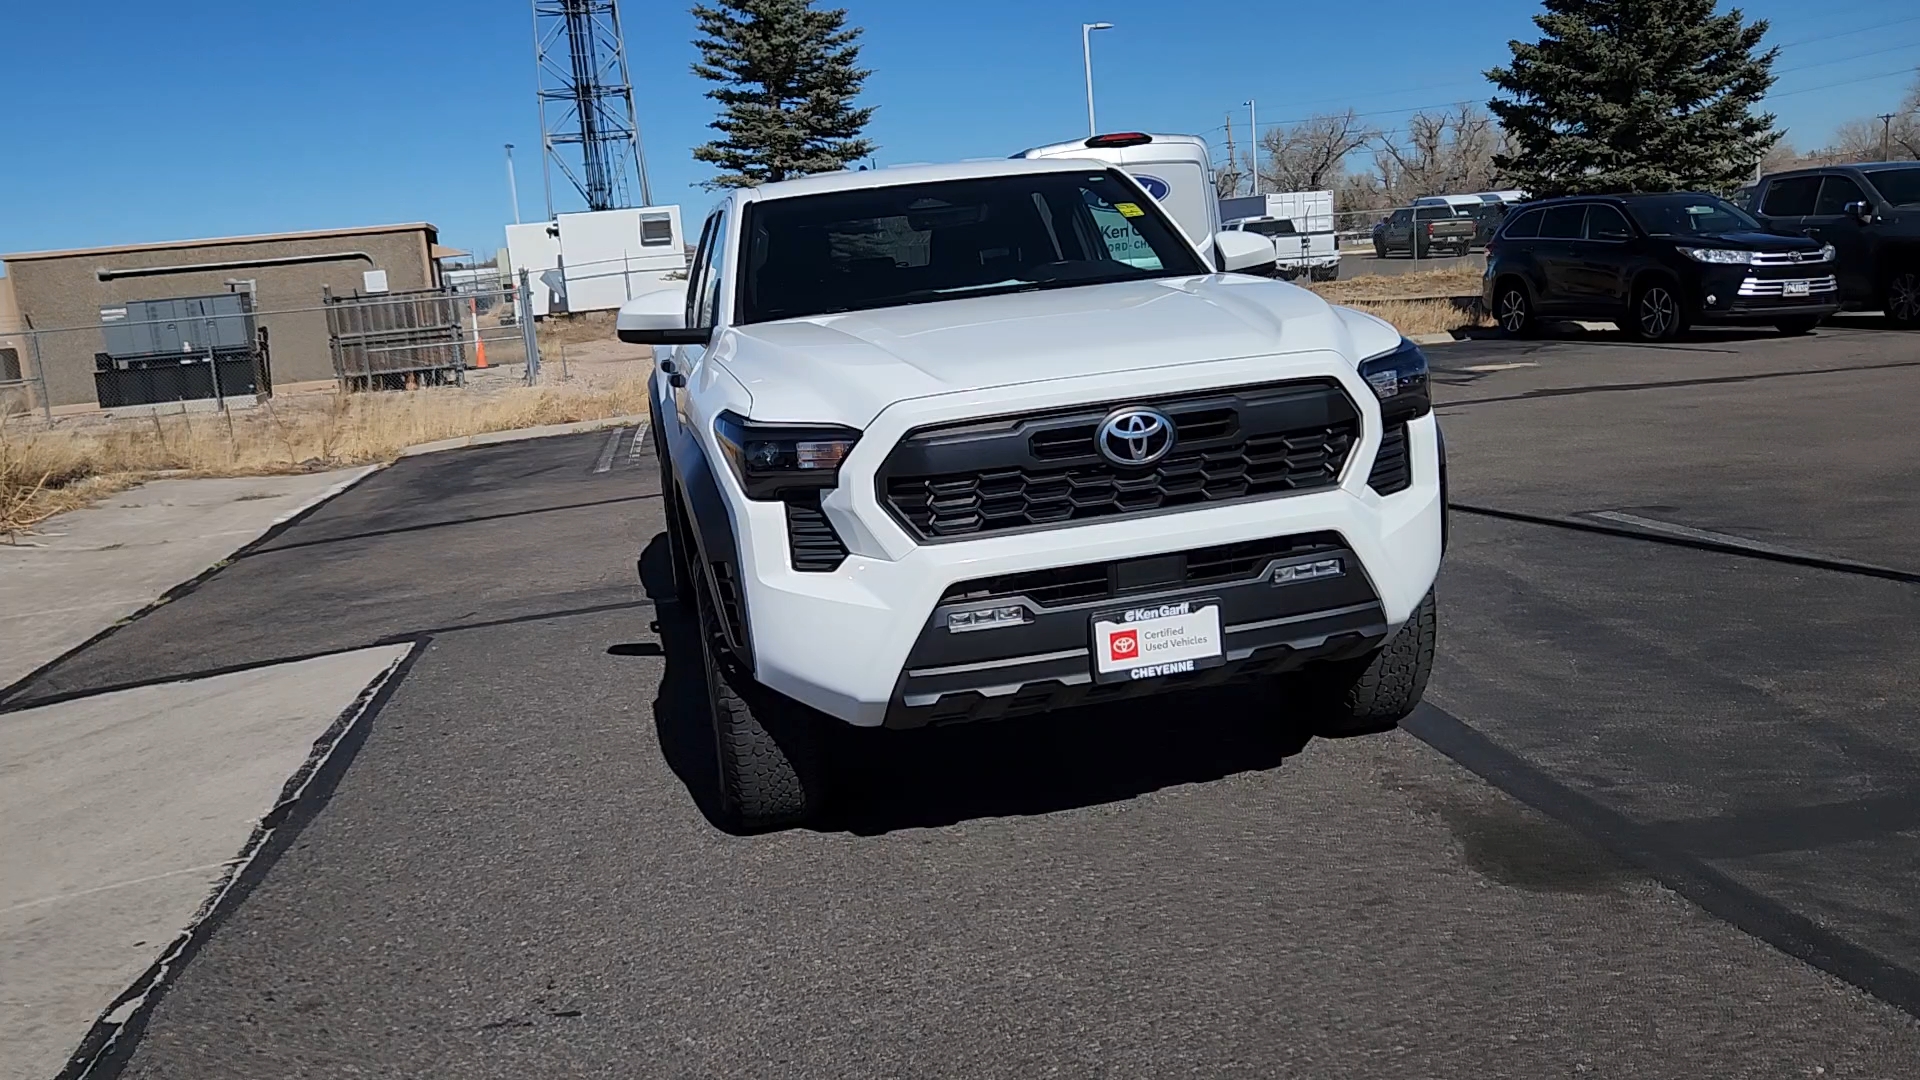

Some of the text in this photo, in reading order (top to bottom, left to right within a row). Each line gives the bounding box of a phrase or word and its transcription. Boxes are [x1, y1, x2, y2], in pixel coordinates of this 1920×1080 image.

[1101, 225, 1129, 239] Ken
[1135, 602, 1190, 621] Ken Garff
[1144, 626, 1184, 639] Certified
[1145, 636, 1208, 651] Used Vehicles
[1131, 660, 1195, 680] CHEYENNE
